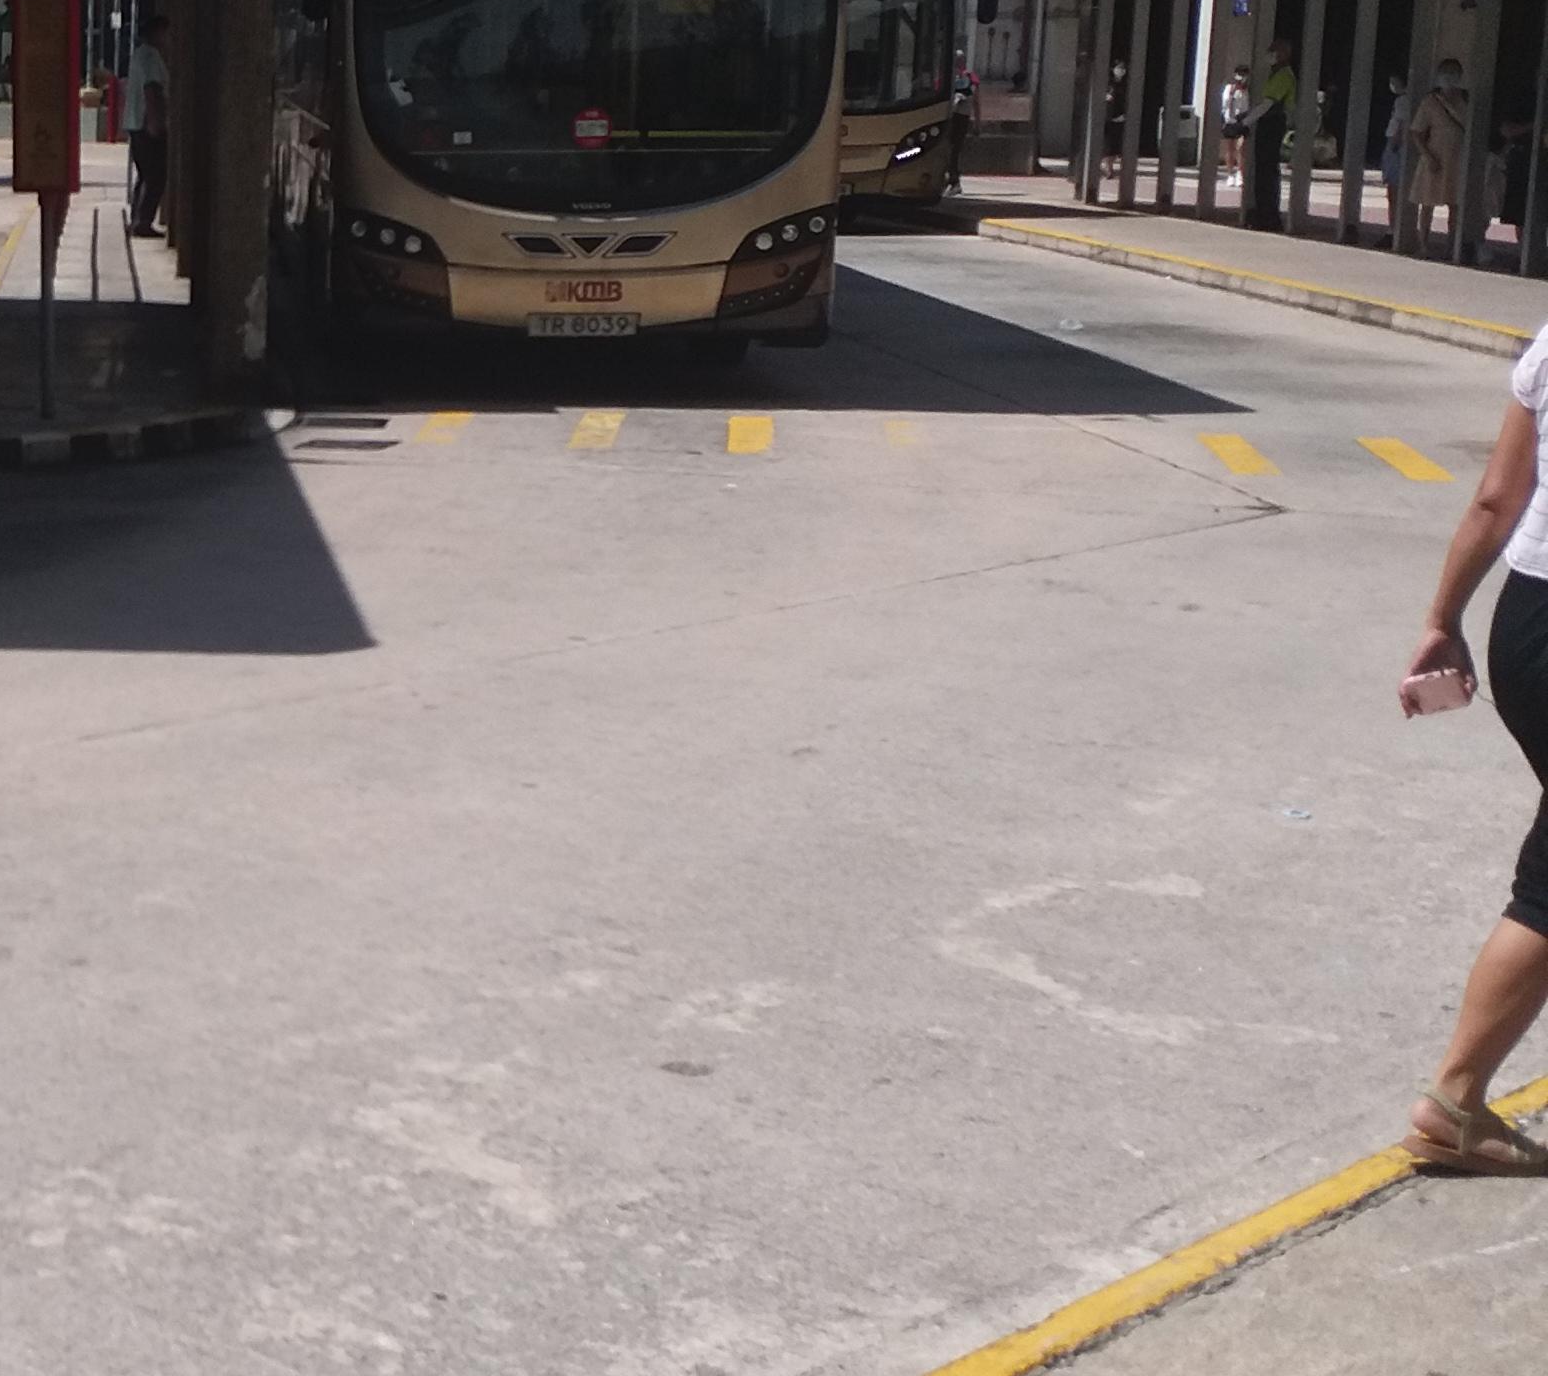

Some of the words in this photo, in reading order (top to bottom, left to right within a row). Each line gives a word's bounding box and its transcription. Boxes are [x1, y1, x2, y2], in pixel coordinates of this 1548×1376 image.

[568, 280, 623, 303] KMB
[539, 317, 566, 333] TR
[572, 316, 630, 333] 8039
